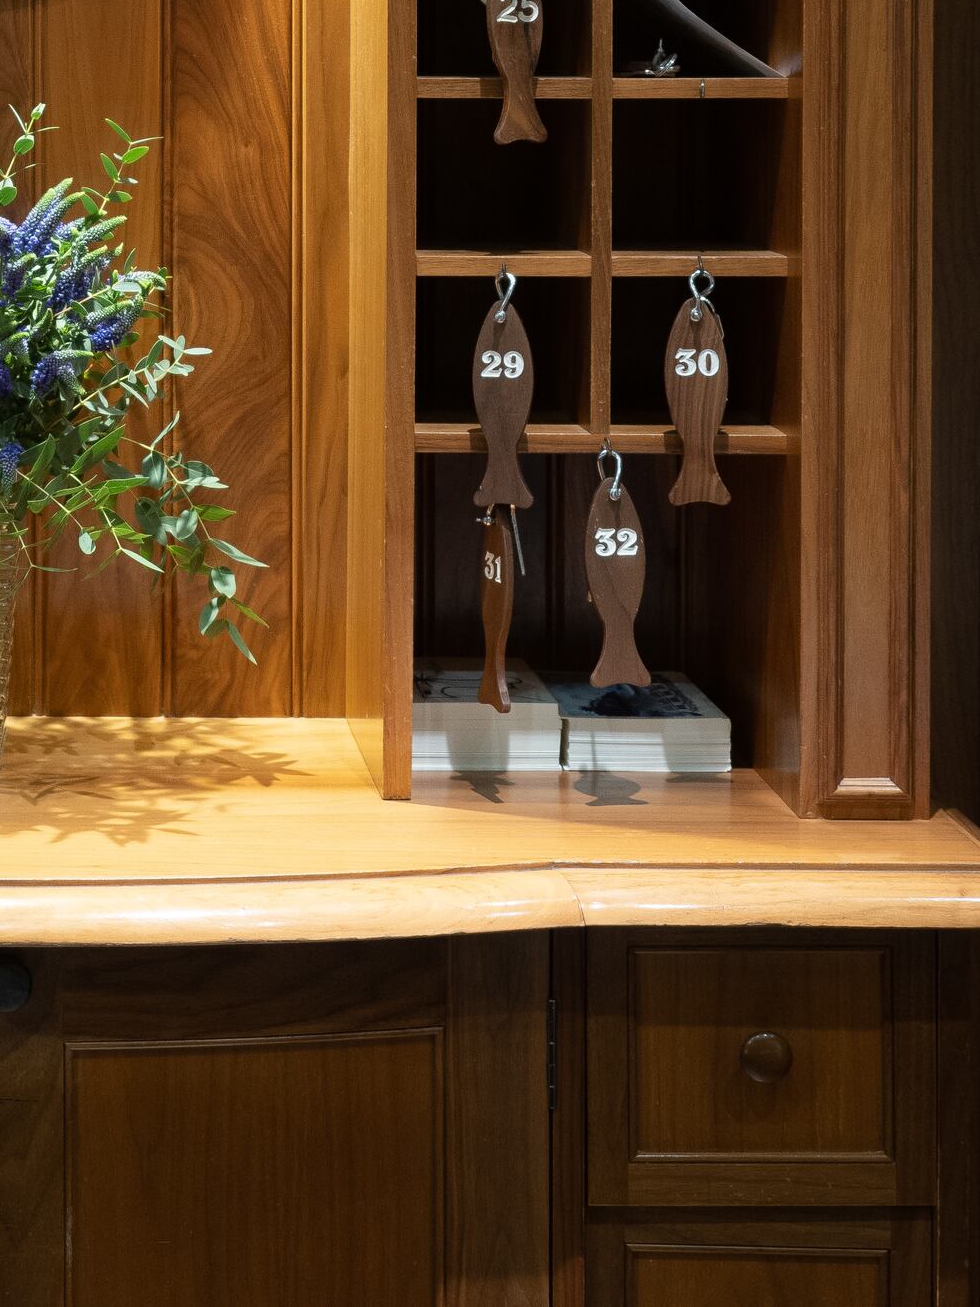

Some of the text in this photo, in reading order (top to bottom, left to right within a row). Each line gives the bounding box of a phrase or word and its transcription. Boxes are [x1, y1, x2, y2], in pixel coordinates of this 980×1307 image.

[480, 350, 525, 379] 29
[674, 347, 720, 377] 30
[594, 527, 639, 557] 32
[484, 551, 502, 584] 31
